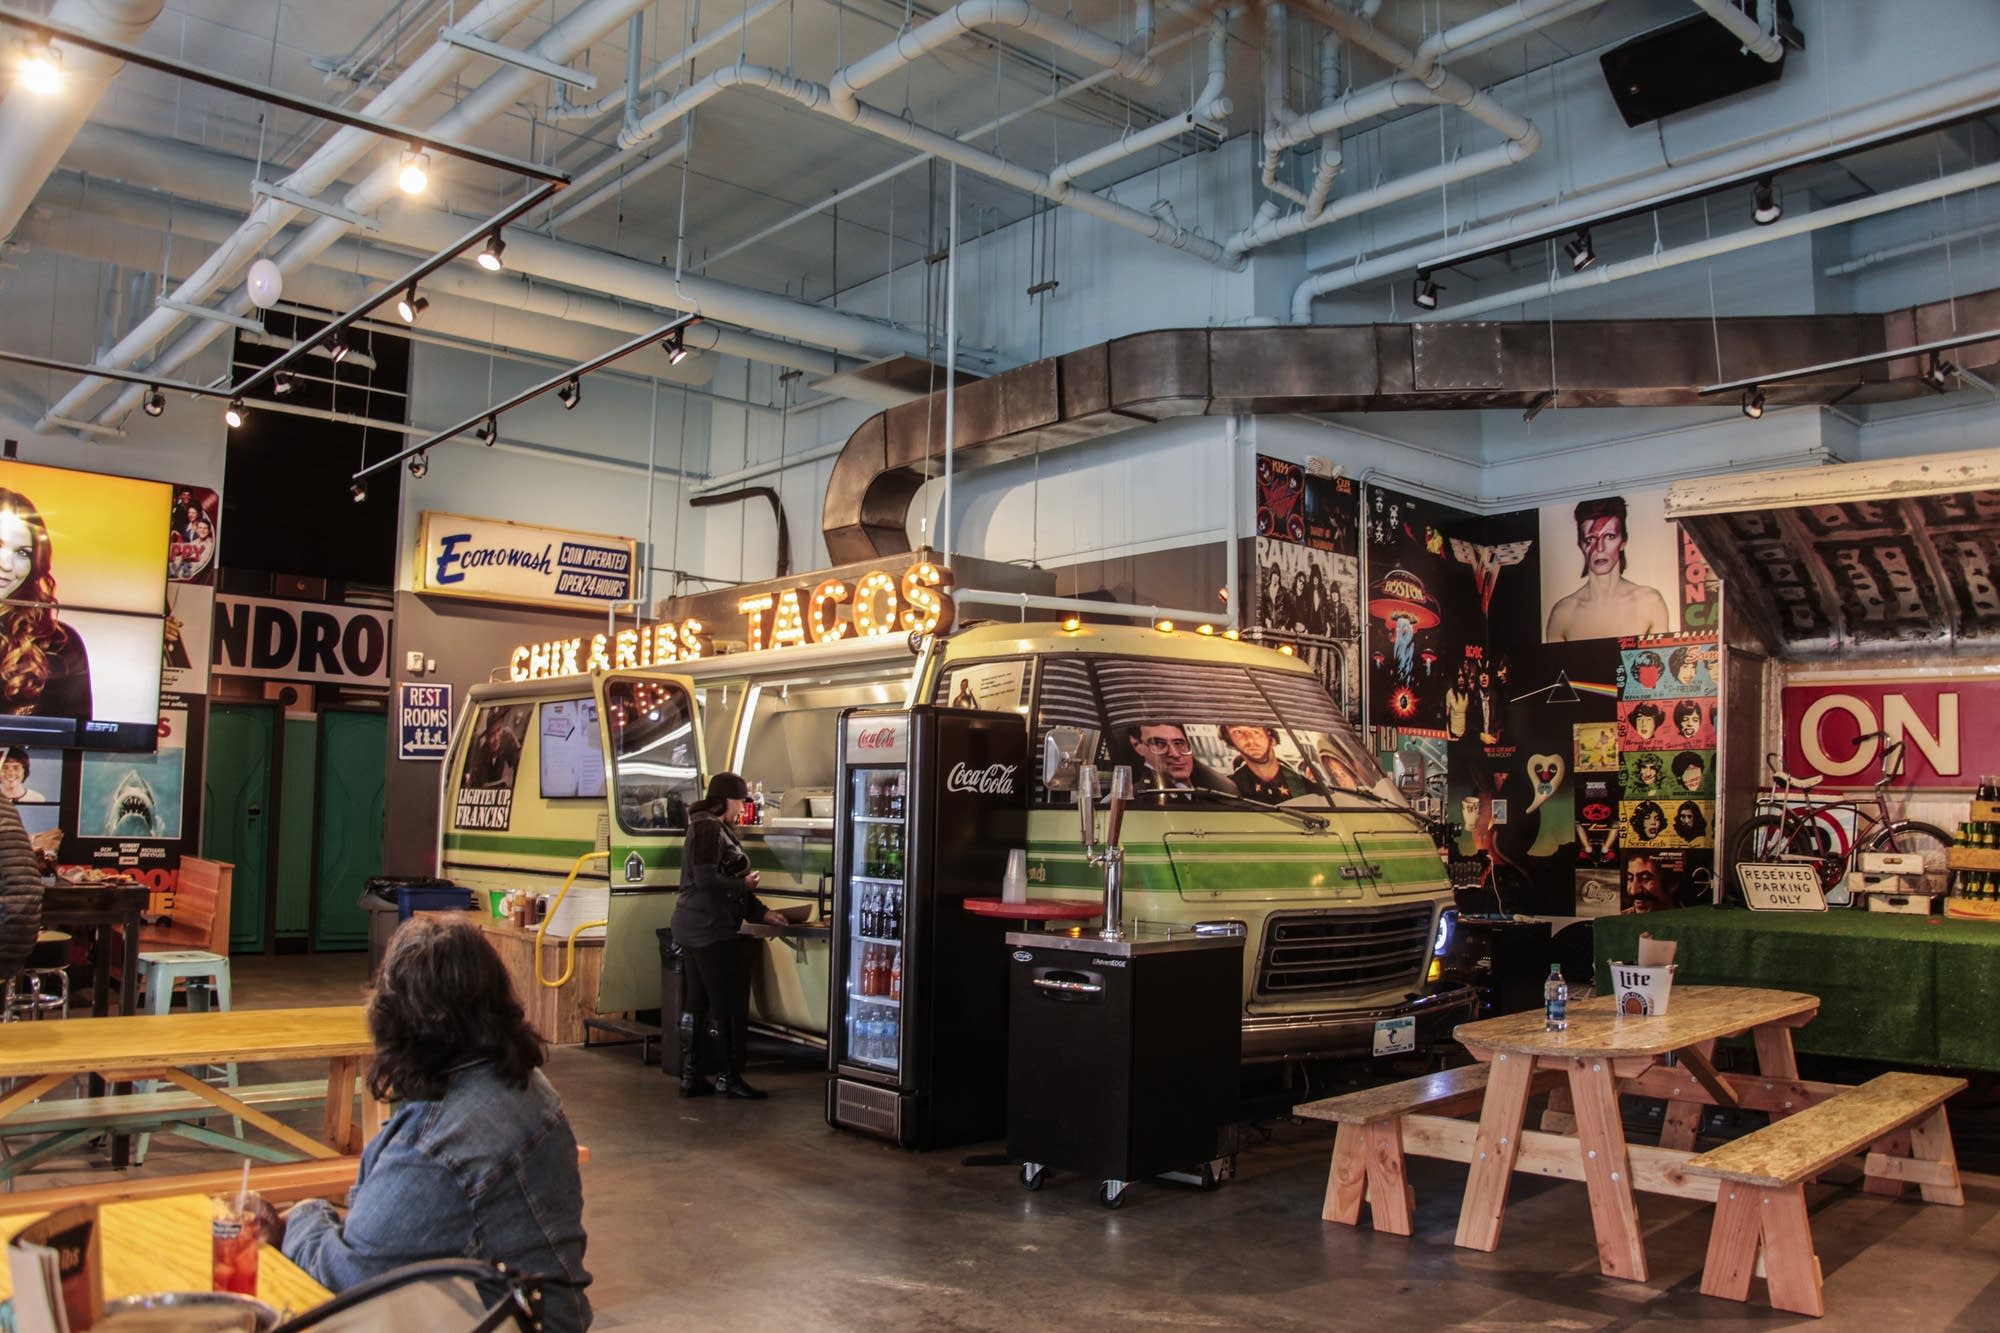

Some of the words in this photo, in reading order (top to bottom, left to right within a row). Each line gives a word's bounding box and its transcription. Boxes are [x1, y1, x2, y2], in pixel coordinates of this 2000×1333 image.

[561, 546, 583, 564] COIN
[583, 549, 628, 571] OPERATED
[1256, 536, 1359, 580] RAMONES
[559, 574, 583, 593] OPEN
[581, 575, 596, 596] 24
[595, 578, 626, 598] HOURS
[1384, 579, 1426, 601] BOSTON
[738, 562, 945, 652] TACOS
[510, 638, 581, 682] CHIX
[587, 632, 609, 672] &
[614, 617, 703, 671] RIBS
[410, 688, 442, 707] REST
[85, 722, 119, 733] ESPN
[403, 708, 448, 727] ROOMS
[857, 727, 896, 749] Coca-Cola
[1800, 693, 1960, 777] ON
[458, 788, 498, 805] LIGHTEN
[455, 806, 509, 829] FRANCIS!
[1744, 870, 1812, 881] RESERVED
[1754, 882, 1811, 893] PARKING
[1769, 894, 1801, 904] ONLY
[1620, 971, 1651, 989] Lite
